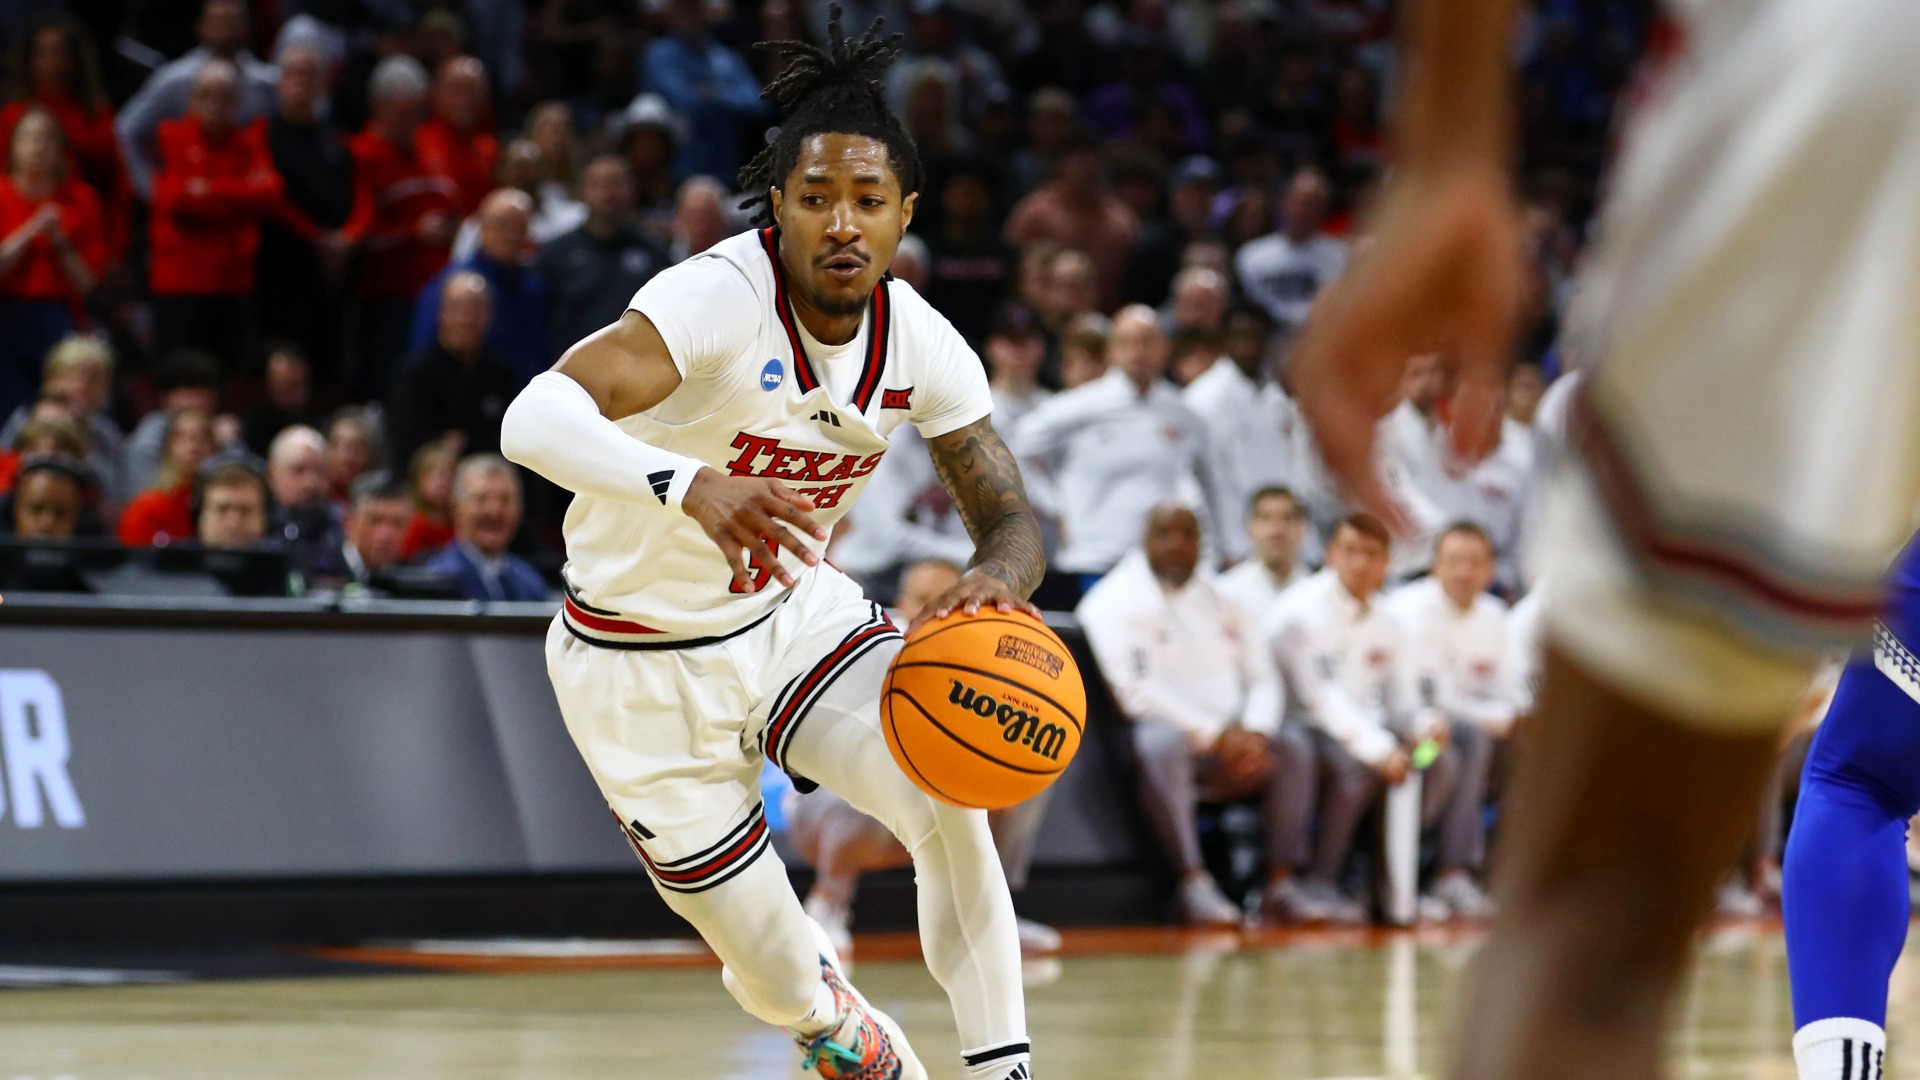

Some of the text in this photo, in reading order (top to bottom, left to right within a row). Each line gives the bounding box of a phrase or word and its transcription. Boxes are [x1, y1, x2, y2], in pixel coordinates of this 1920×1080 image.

[763, 373, 782, 384] NCAA
[726, 431, 888, 482] TEXAS
[948, 680, 1067, 761] Wilson
[1001, 692, 1040, 713] EVO NXT
